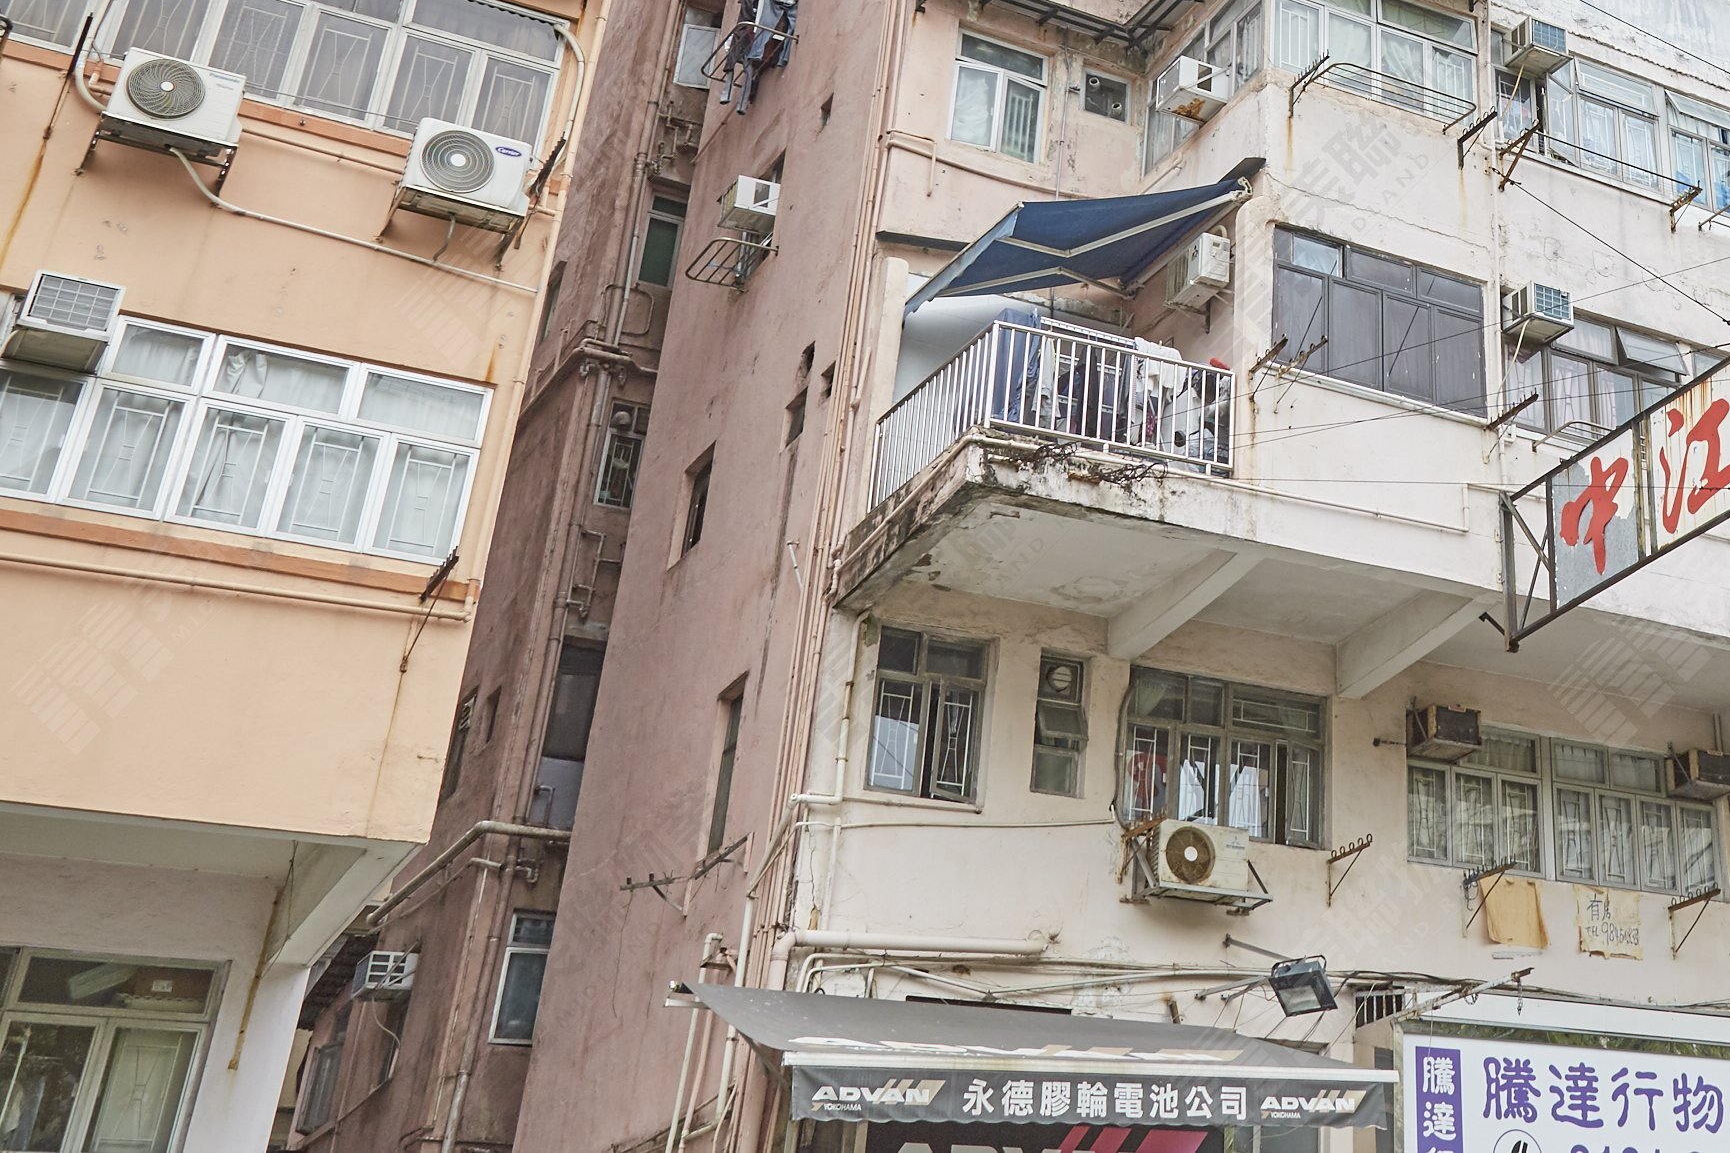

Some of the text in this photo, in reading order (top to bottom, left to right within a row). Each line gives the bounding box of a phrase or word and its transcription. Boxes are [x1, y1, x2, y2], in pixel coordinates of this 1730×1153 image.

[812, 1081, 939, 1105] ADVAN
[962, 1078, 1247, 1121] 永德膠輪電池公司
[1260, 1093, 1361, 1114] ADVAN
[823, 1103, 862, 1112] YOKOHAMA
[1270, 1111, 1302, 1119] YOKOHAMA
